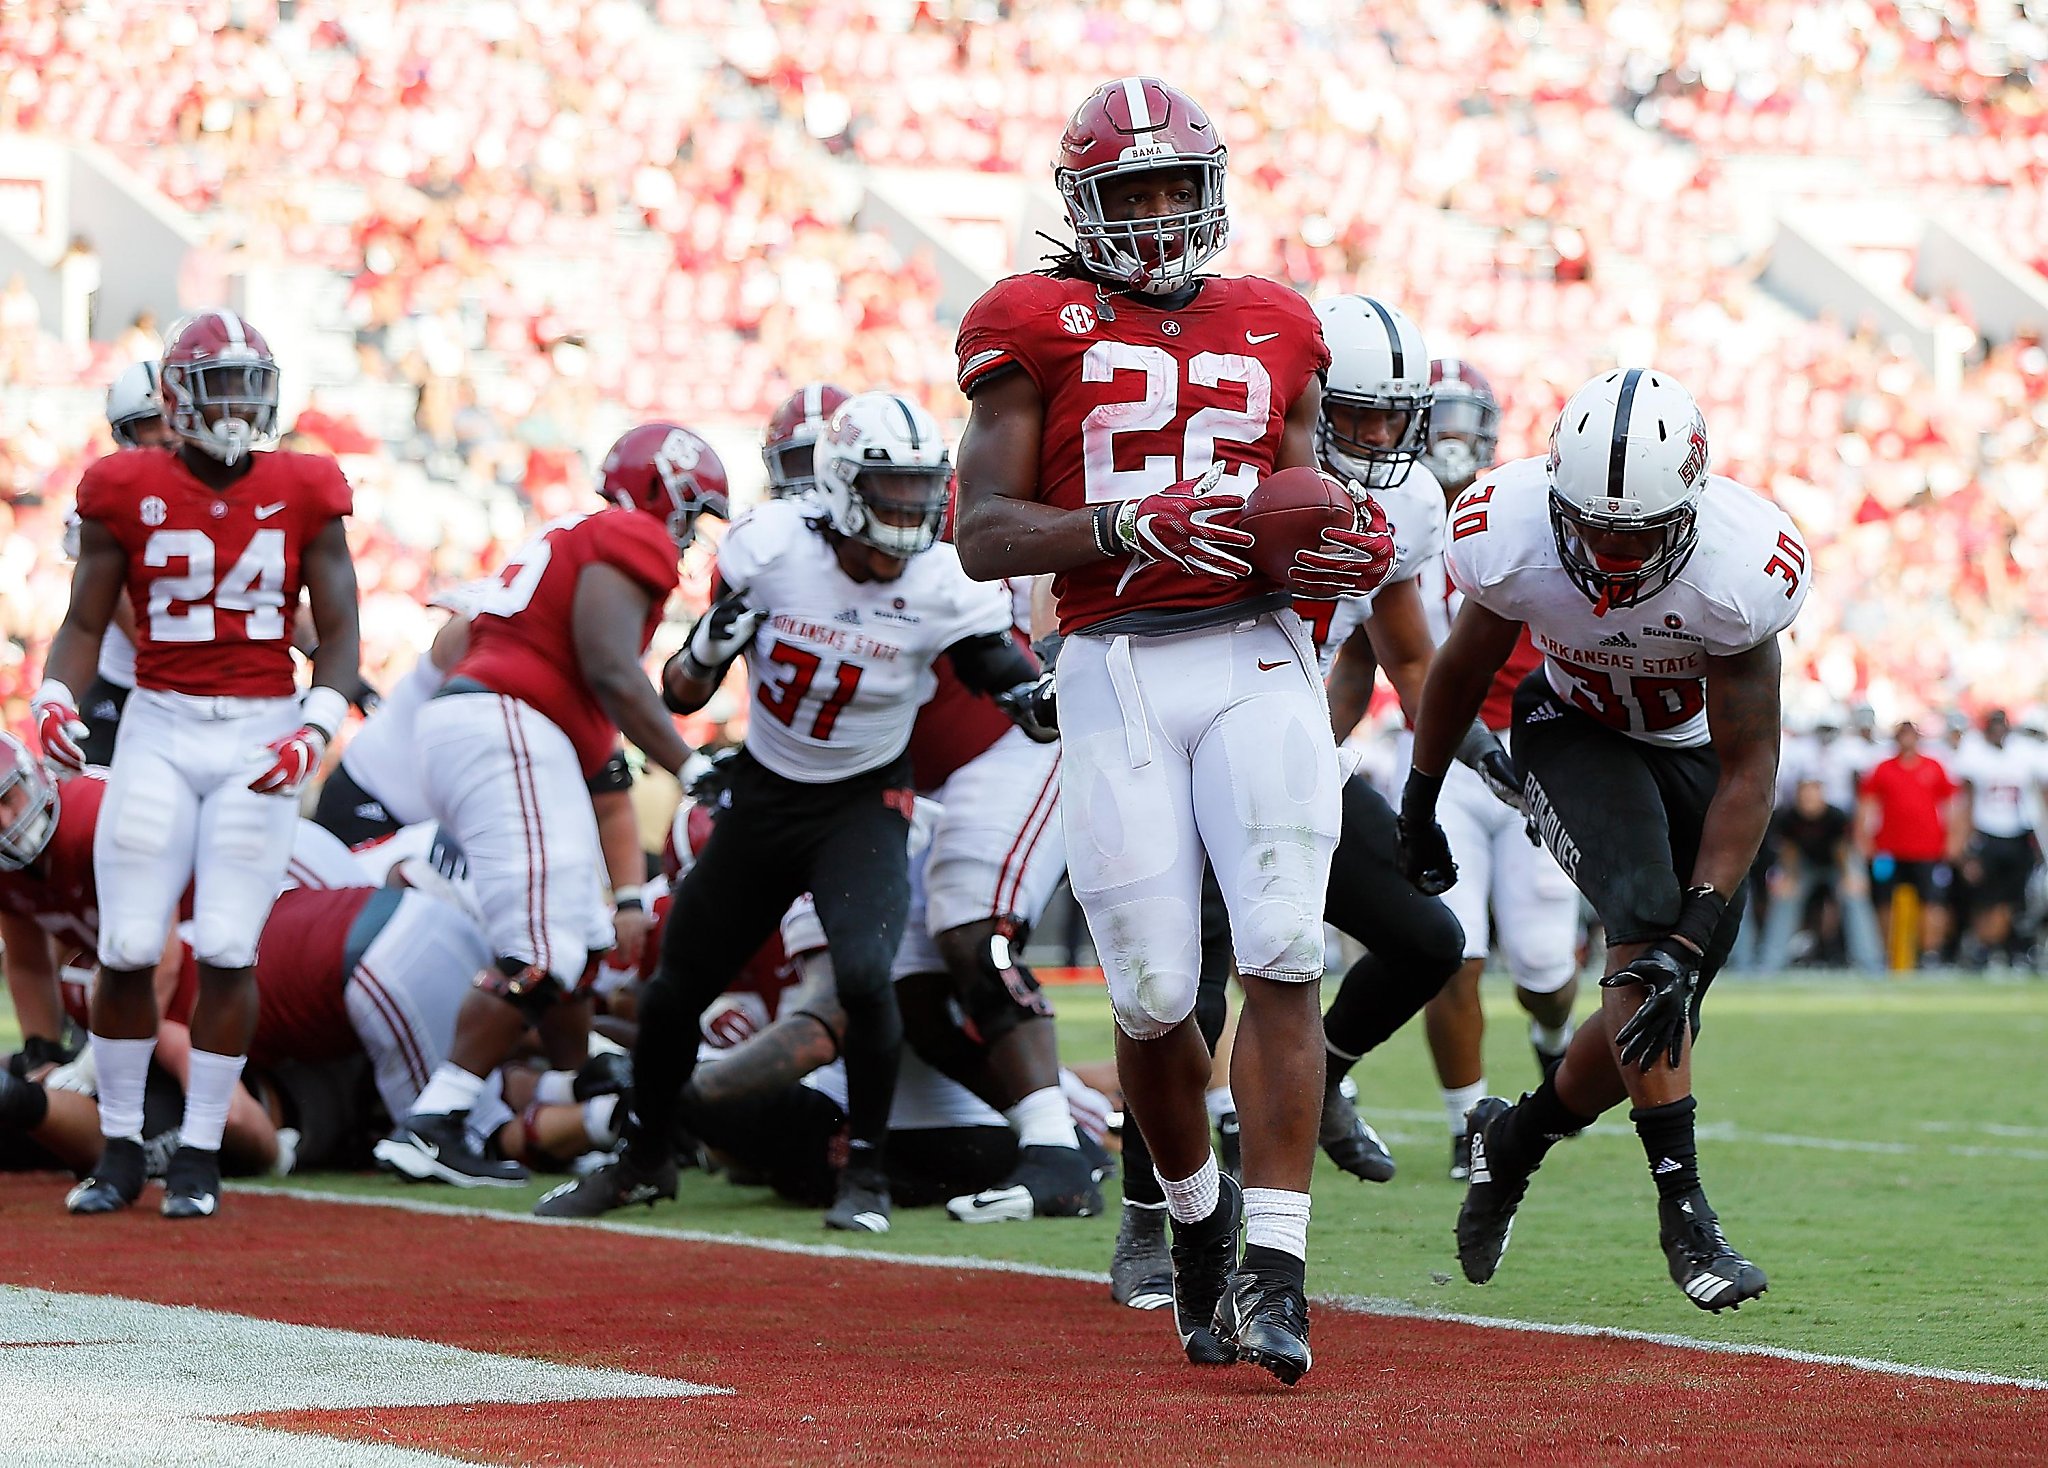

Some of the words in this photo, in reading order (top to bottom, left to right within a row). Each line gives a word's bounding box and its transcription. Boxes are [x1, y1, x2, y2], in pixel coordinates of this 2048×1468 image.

[1131, 146, 1162, 158] BAMA
[1060, 304, 1096, 334] SEC
[1081, 340, 1272, 505] 22
[1453, 485, 1496, 542] 30
[144, 528, 287, 642] 24
[1763, 530, 1805, 600] 30
[1538, 634, 1634, 670] ARKANSAS
[1642, 651, 1698, 674] STATE
[1598, 638, 1638, 649] adidas
[757, 640, 864, 741] 31
[1547, 653, 1705, 732] 30
